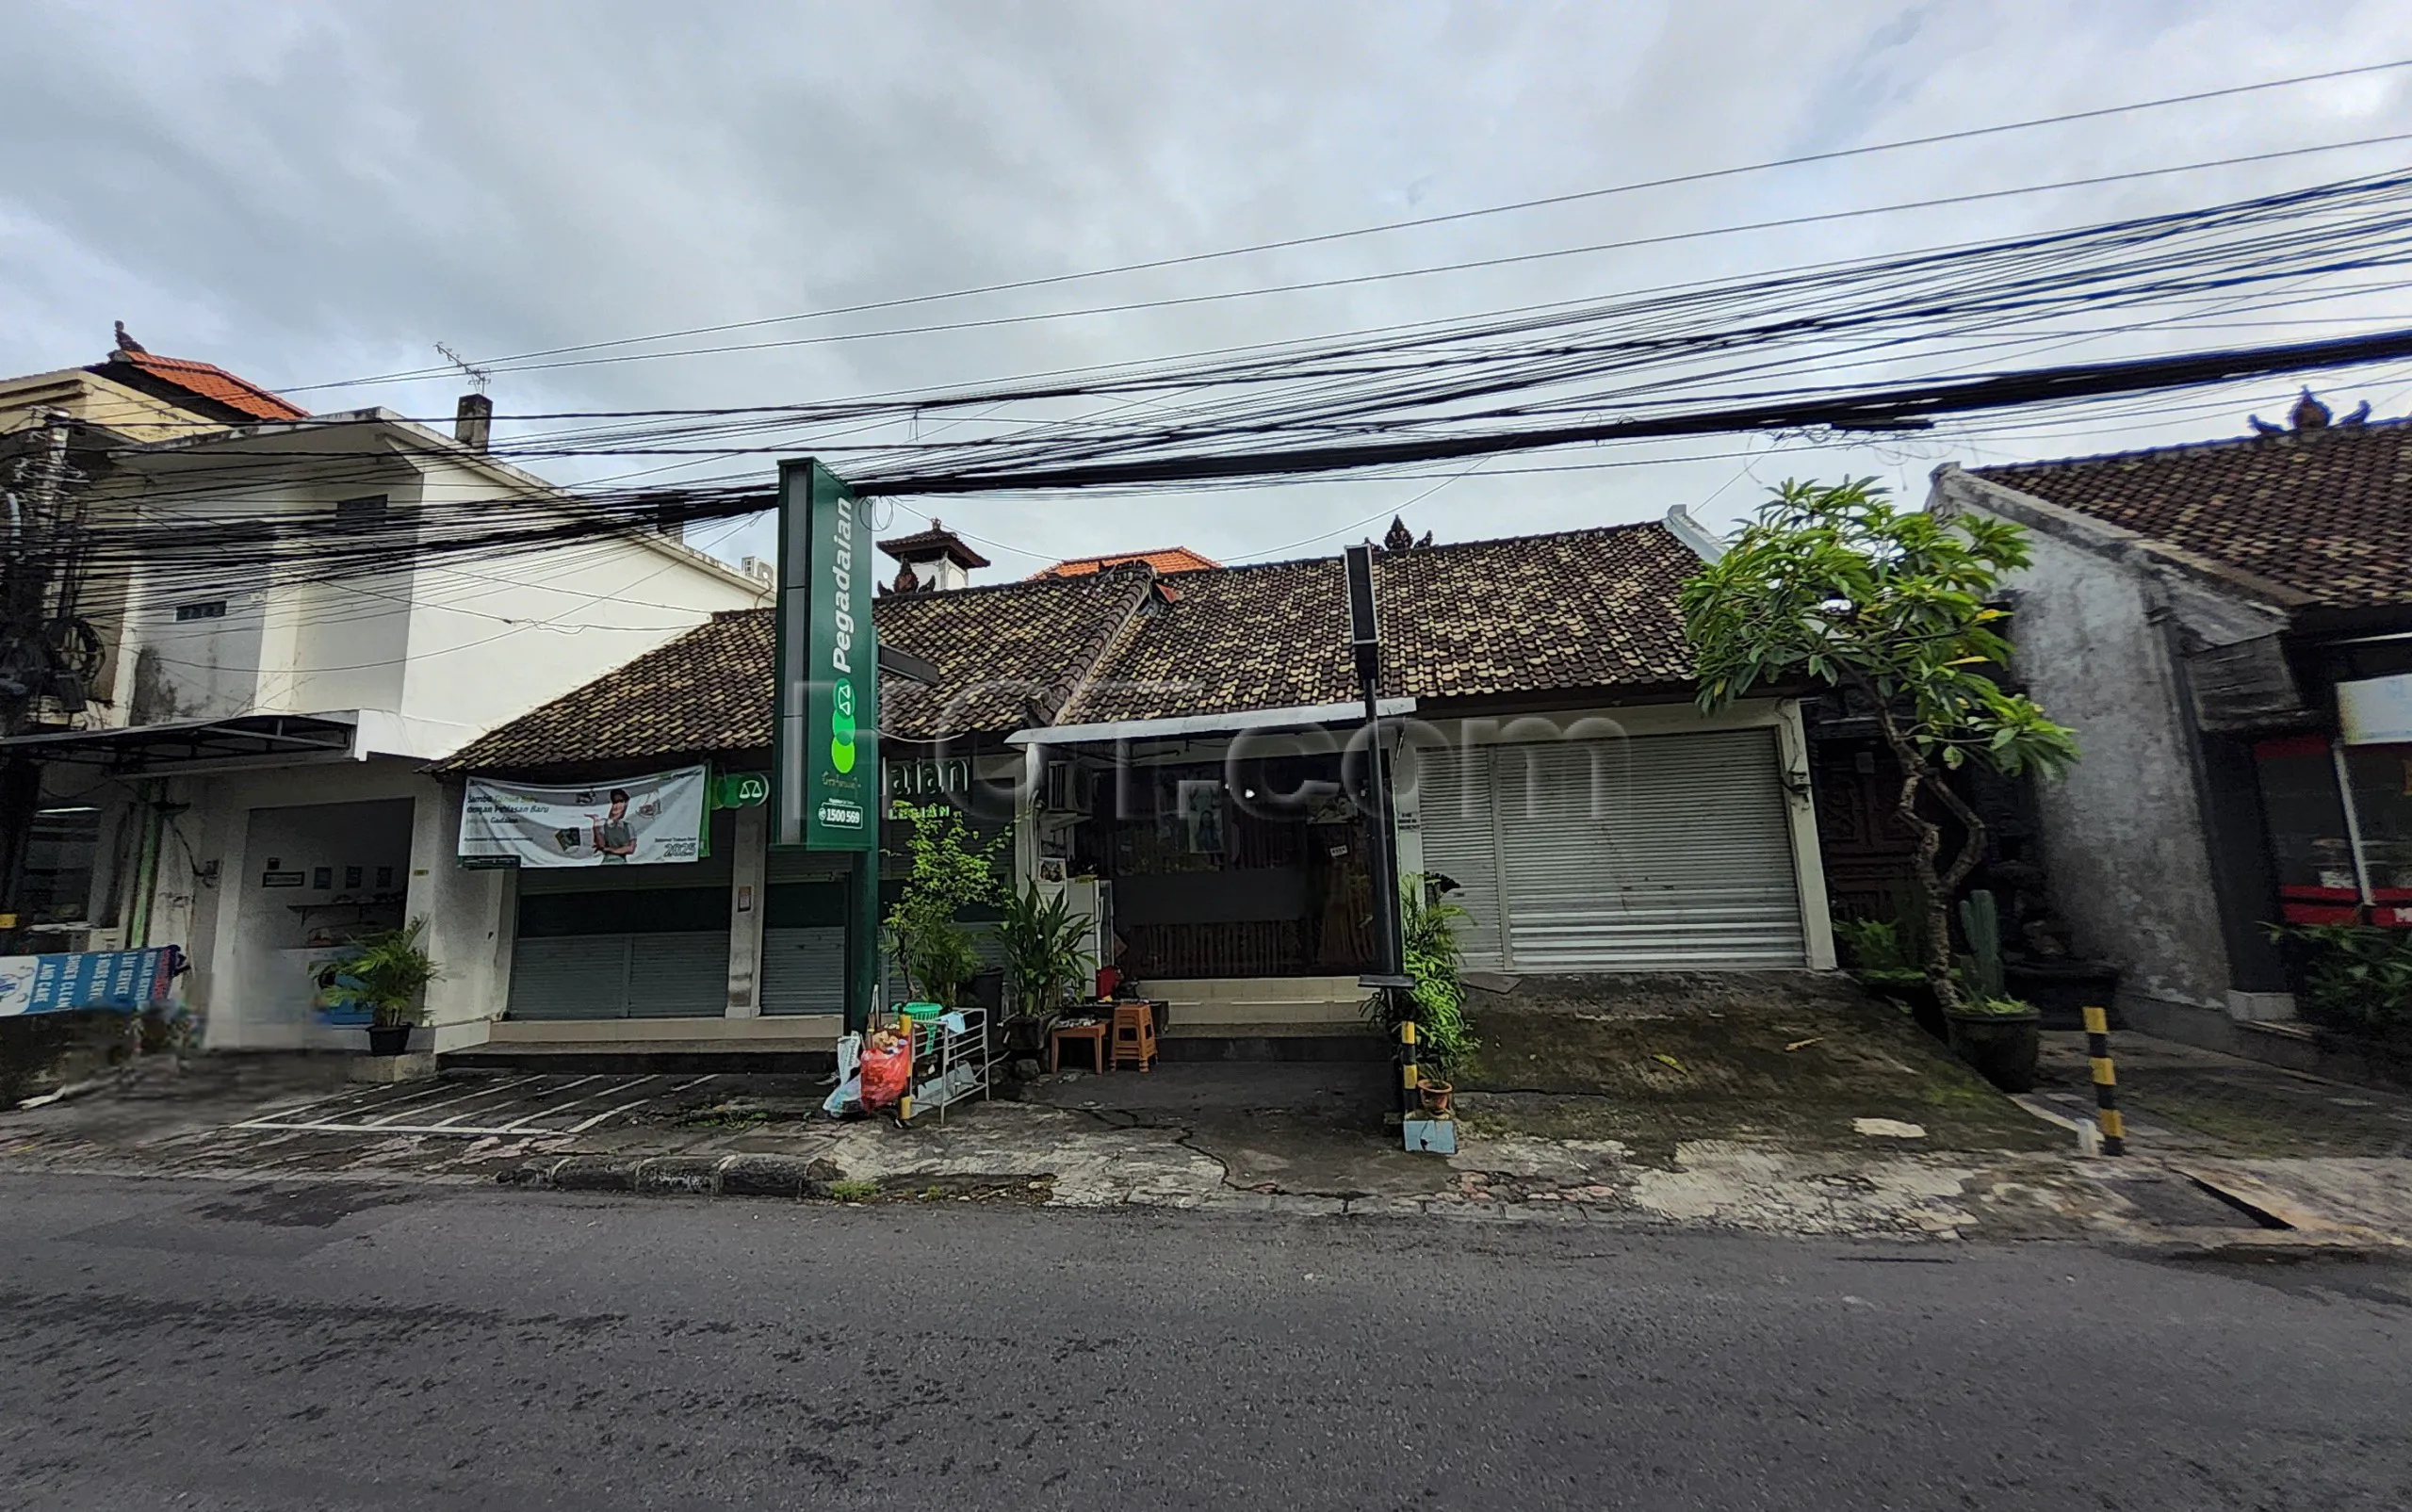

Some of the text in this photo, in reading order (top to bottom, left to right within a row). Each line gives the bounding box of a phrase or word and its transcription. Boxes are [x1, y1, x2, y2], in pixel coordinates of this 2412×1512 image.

[833, 496, 854, 674] Pegadaian
[826, 807, 860, 824] 1500 569
[663, 842, 696, 857] 2025
[33, 964, 57, 1003] AND CARE
[113, 969, 134, 996] SERVICE
